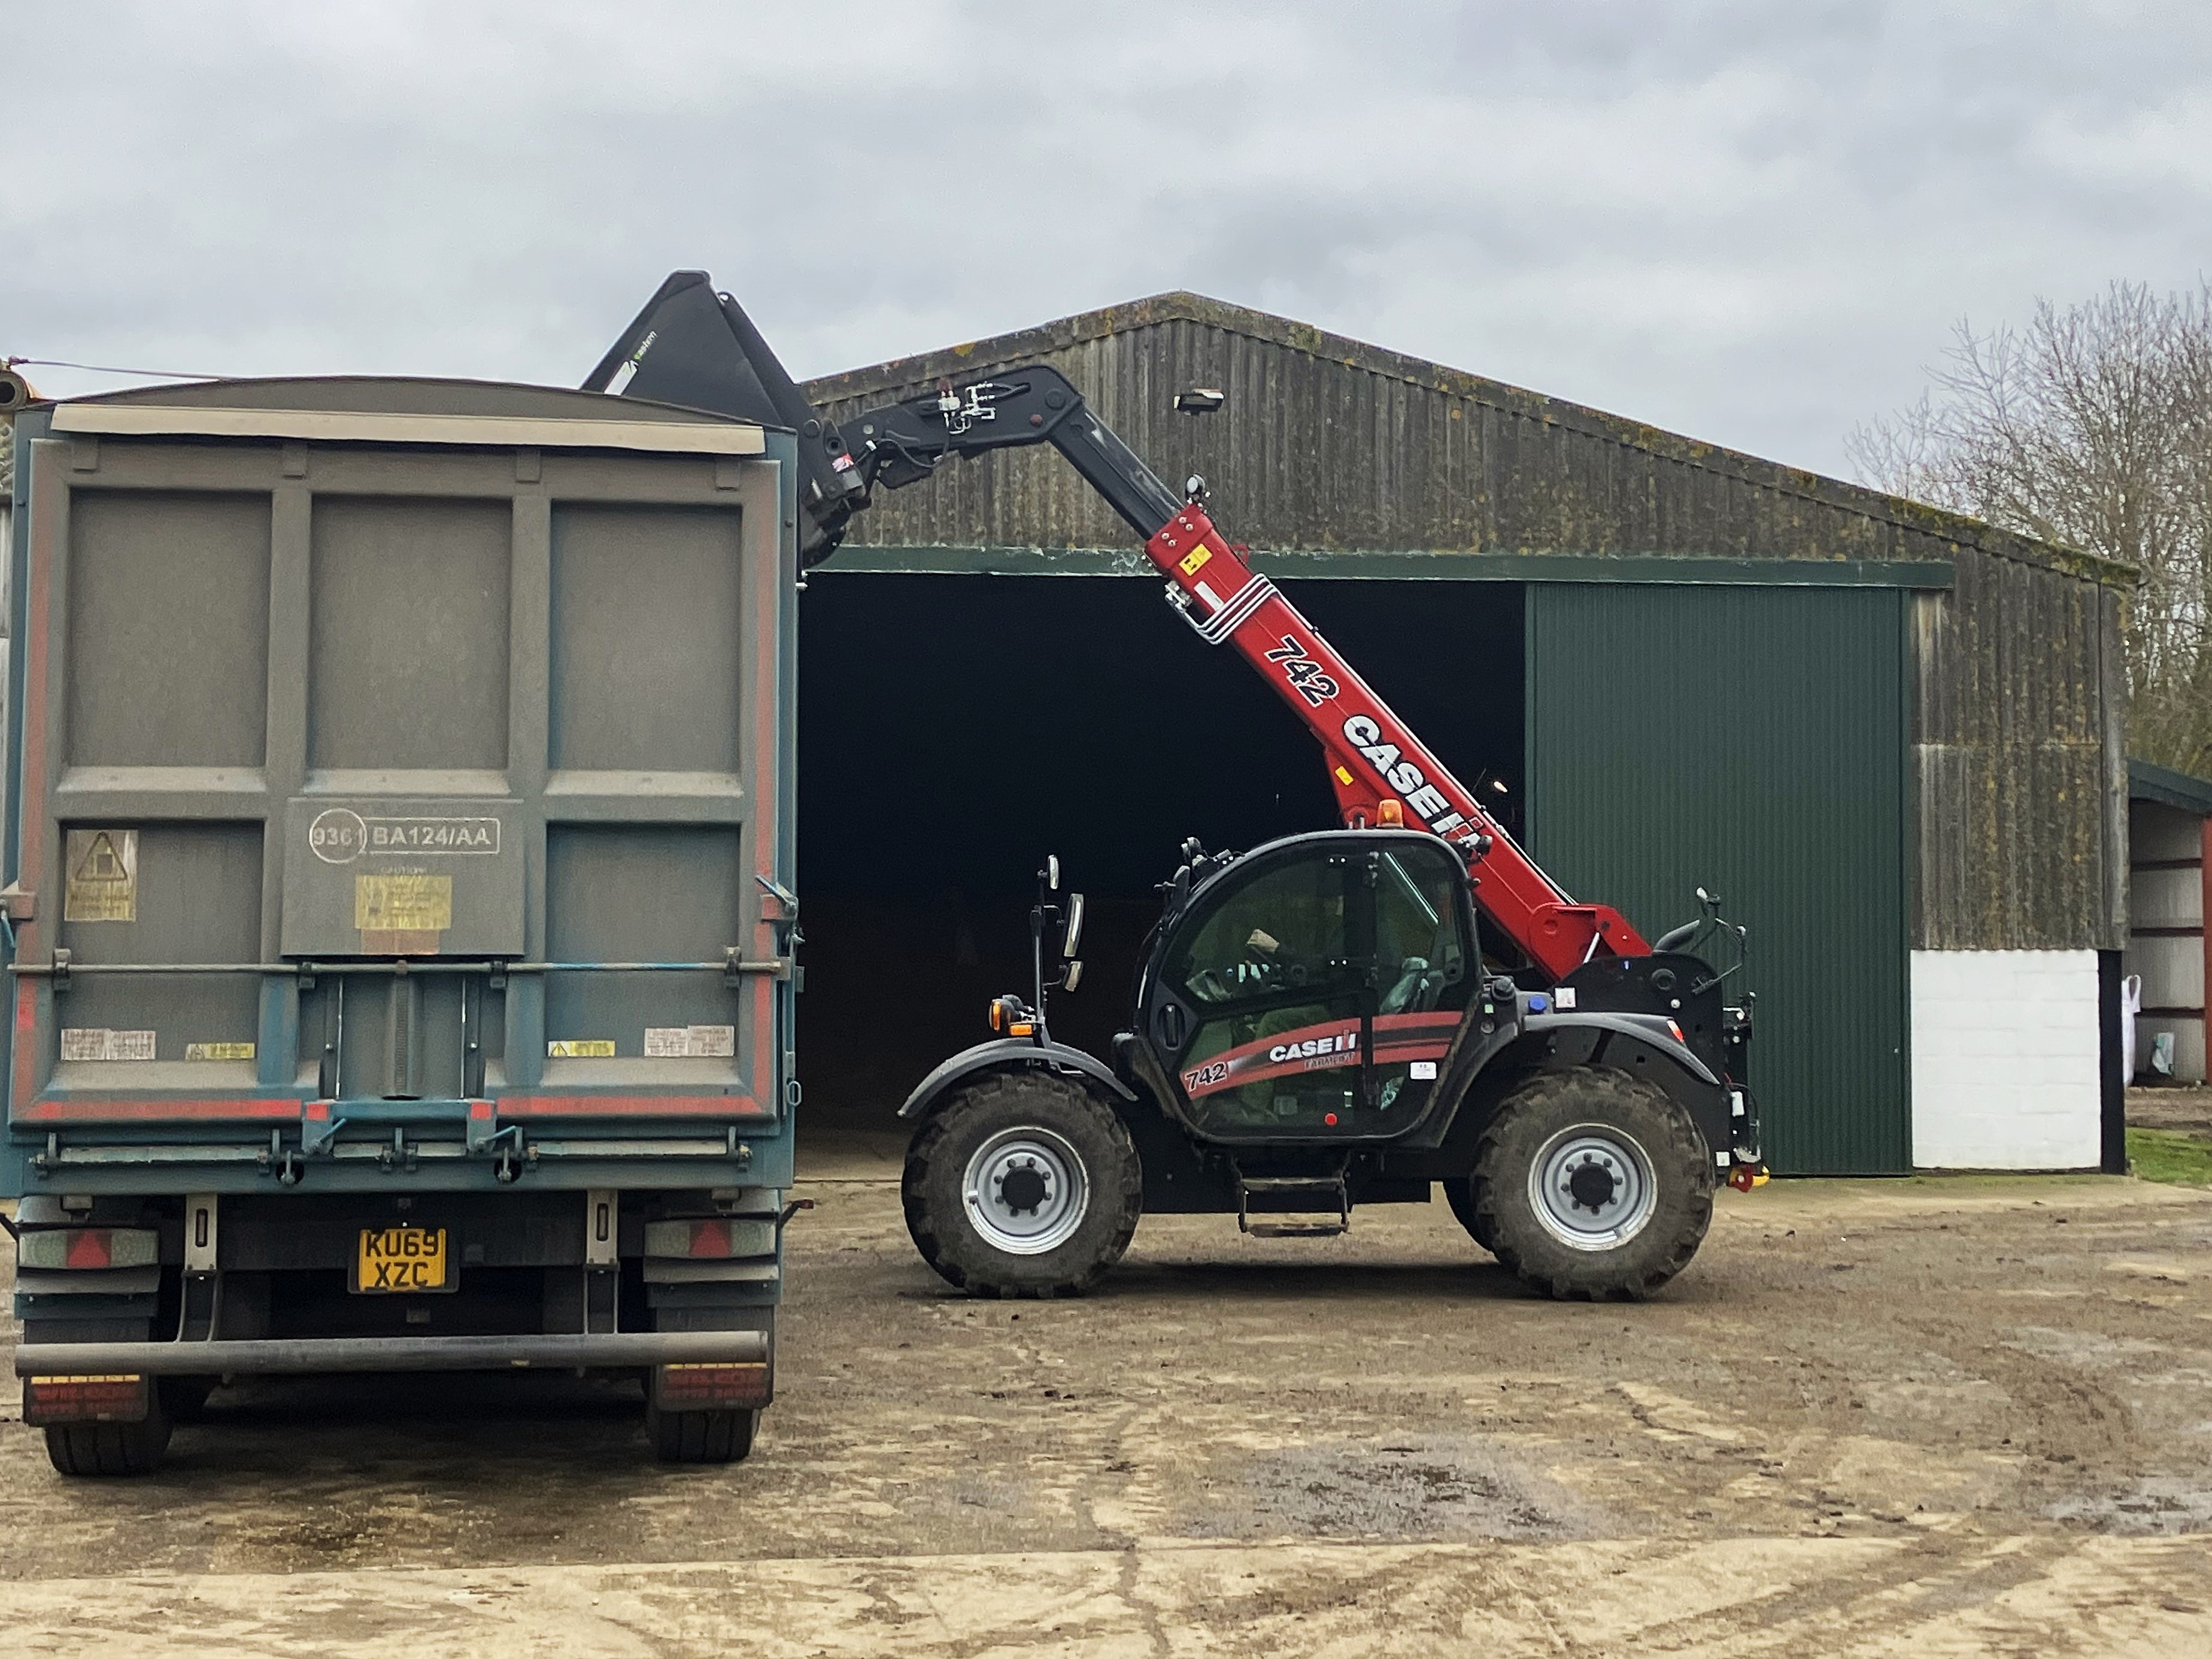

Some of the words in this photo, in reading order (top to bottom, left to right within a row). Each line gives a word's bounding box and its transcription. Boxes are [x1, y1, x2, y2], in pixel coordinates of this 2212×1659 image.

[1264, 633, 1339, 708] 742
[1343, 715, 1451, 820] CASE
[372, 826, 491, 846] BA124/AA
[1269, 1038, 1333, 1063] CASE
[1185, 1061, 1227, 1092] 742
[366, 1231, 438, 1257] KU69
[375, 1261, 428, 1287] XZC
